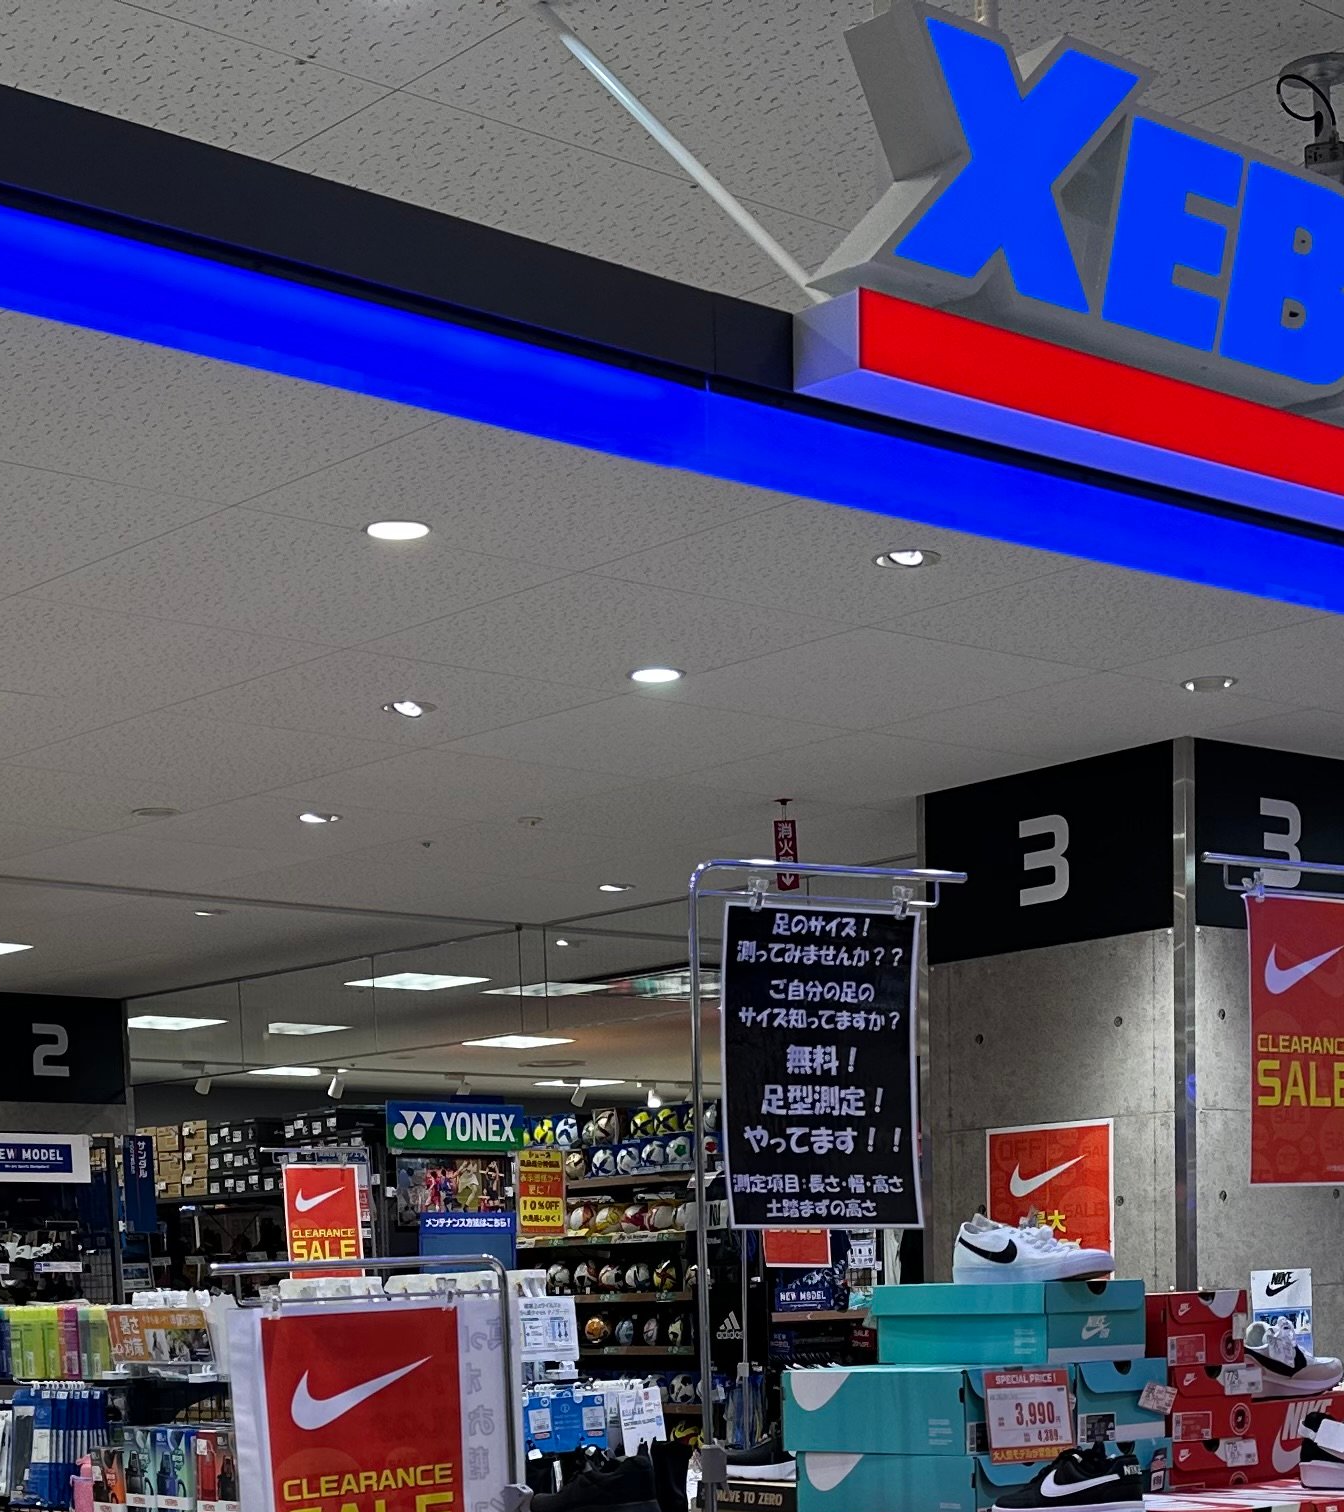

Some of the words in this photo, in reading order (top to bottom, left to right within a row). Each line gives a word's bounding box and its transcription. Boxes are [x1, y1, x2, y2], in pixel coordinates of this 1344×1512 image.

[1260, 797, 1301, 888] 3
[1018, 814, 1070, 906] 3
[772, 912, 870, 937] 足のサイズ！
[737, 940, 903, 966] 測ってみませんか？？
[769, 979, 875, 1003] ご自分の足の
[739, 1006, 900, 1031] サイズ知ってますか？
[32, 1023, 70, 1077] 2
[786, 1045, 857, 1076] 無料！
[761, 1084, 883, 1116] 足型測定！
[441, 1111, 516, 1142] YONEX
[744, 1125, 902, 1154] やってます！！
[21, 1148, 64, 1161] MODEL
[766, 1198, 878, 1218] 土踏まずの高さ
[292, 1229, 356, 1238] CLEARANCE
[292, 1239, 358, 1262] SALE
[799, 1290, 827, 1301] MODEL
[995, 1373, 1029, 1385] SPECIAL
[1015, 1401, 1055, 1428] 3,990
[283, 1463, 454, 1501] CLEARANCE
[744, 1491, 754, 1505] TO
[758, 1493, 783, 1507] ZERO
